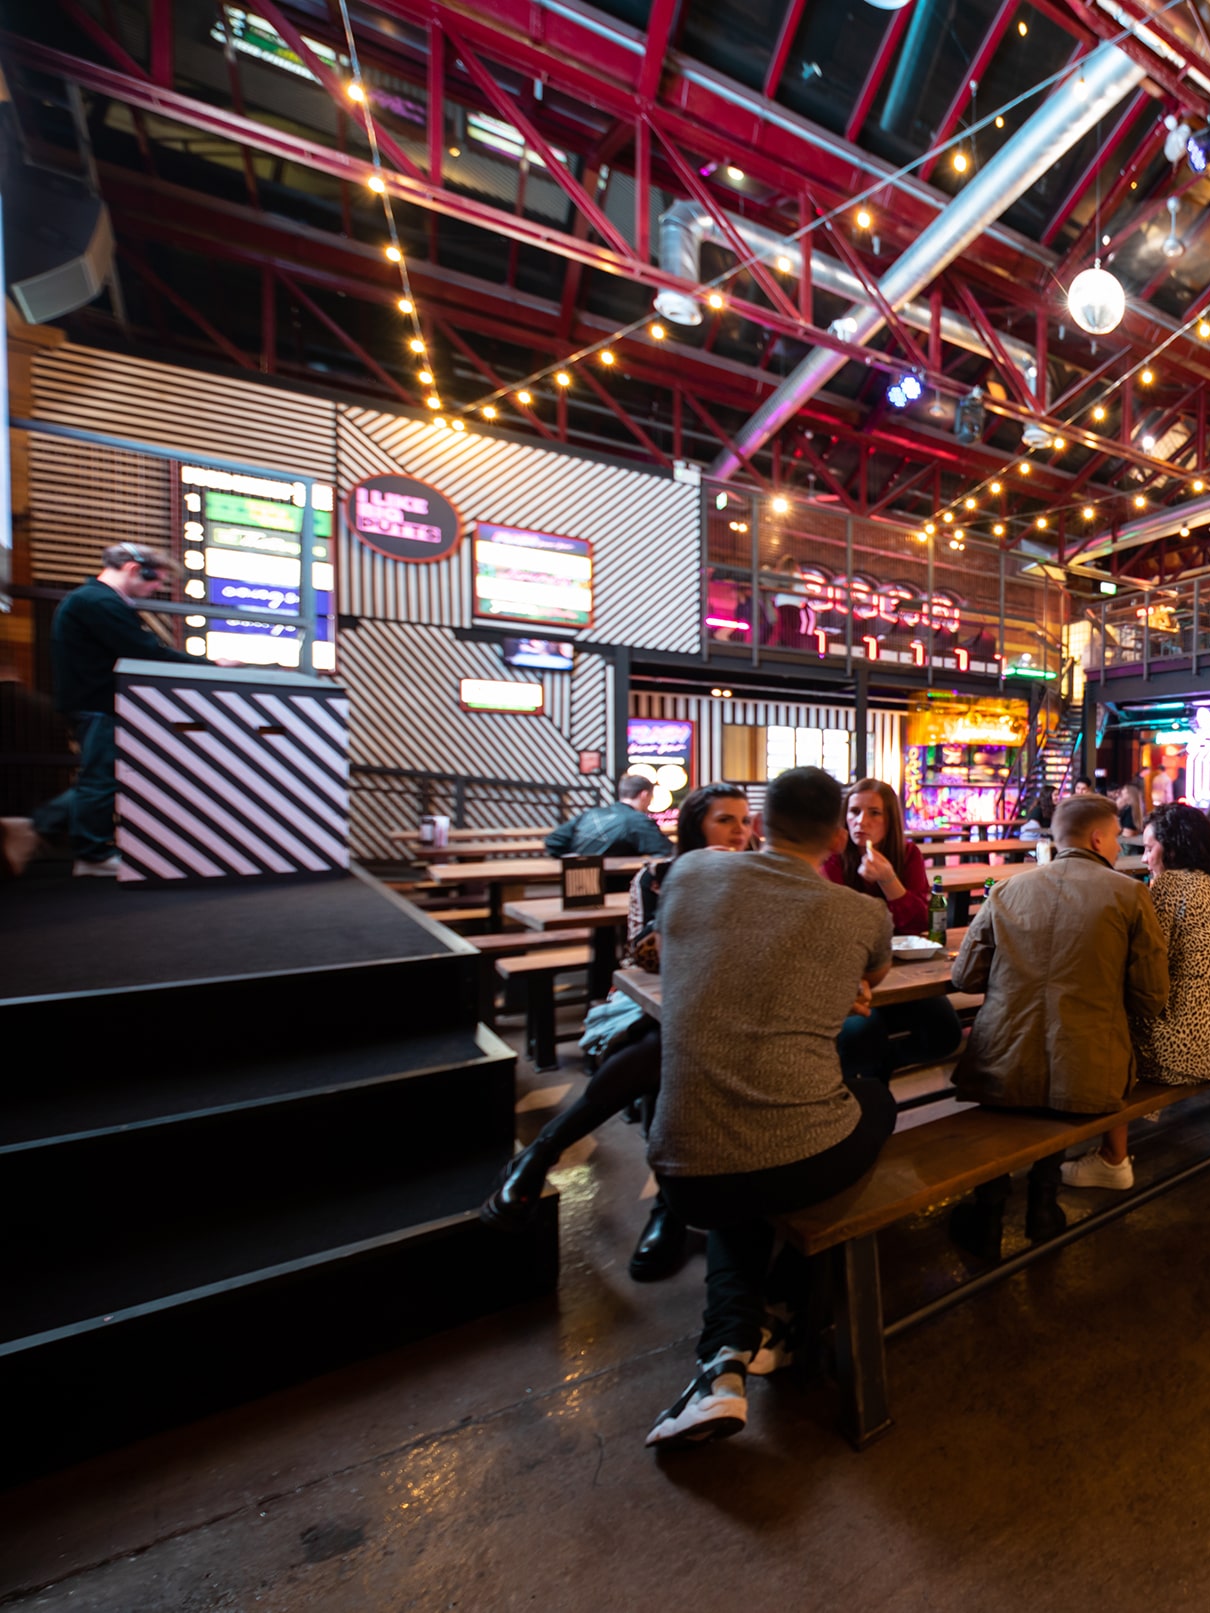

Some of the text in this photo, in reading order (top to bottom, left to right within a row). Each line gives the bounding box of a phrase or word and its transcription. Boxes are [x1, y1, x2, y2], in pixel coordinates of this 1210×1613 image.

[184, 492, 201, 513] 1
[369, 489, 429, 515] LIKE
[184, 520, 204, 542] 2
[356, 515, 442, 544] PUTTS
[184, 578, 206, 600] 4
